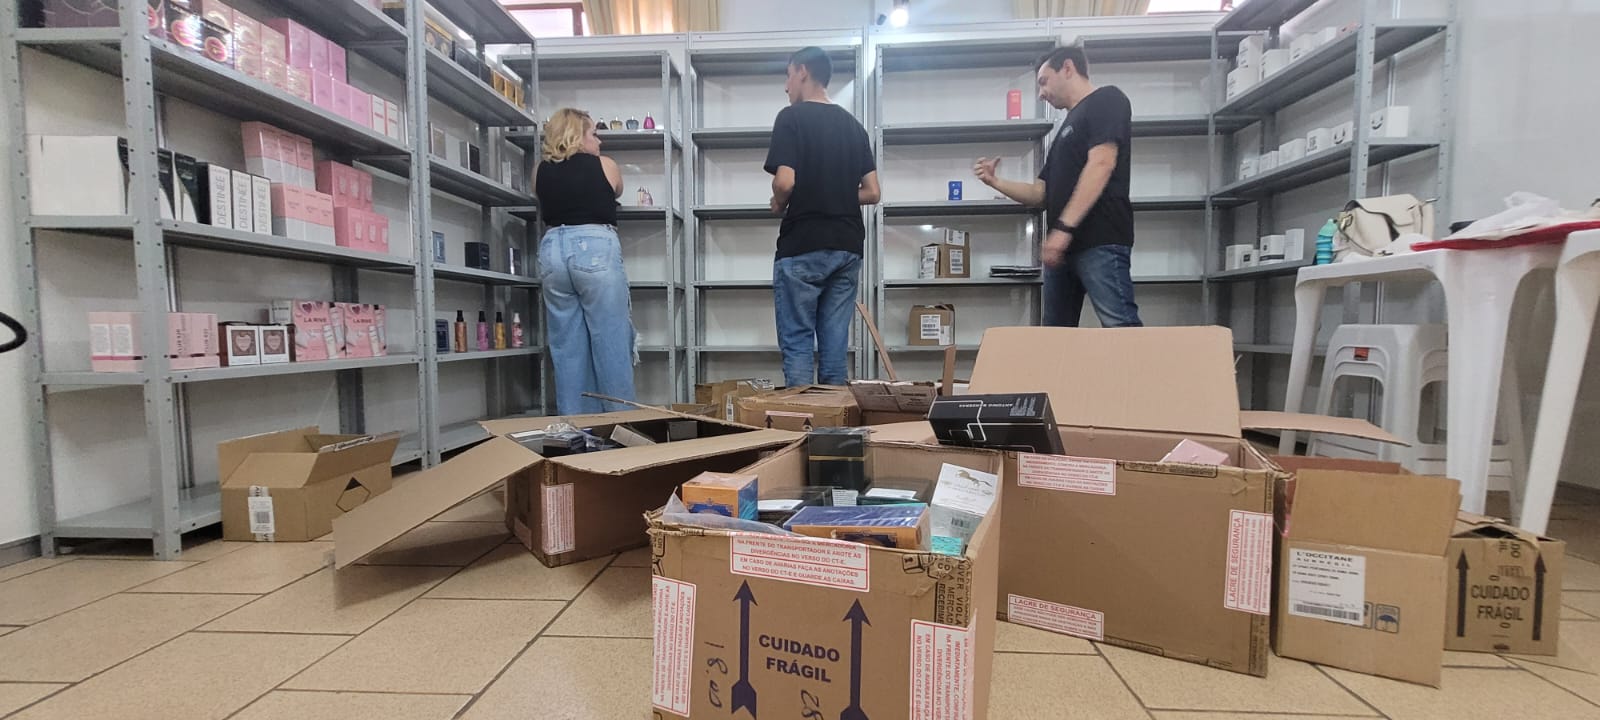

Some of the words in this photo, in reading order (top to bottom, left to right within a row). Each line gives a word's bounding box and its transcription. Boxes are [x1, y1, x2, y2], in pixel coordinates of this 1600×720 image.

[1231, 518, 1242, 565] SEGURANÇA
[1231, 567, 1238, 576] DE
[1470, 584, 1530, 600] CUIDADO
[946, 587, 955, 624] MERCAD
[1014, 598, 1037, 608] LACRE
[1051, 605, 1096, 620] SEGURANÇA
[946, 634, 952, 643] NA
[759, 634, 840, 663] CUIDADO
[766, 656, 831, 683] FRÁGIL
[945, 671, 951, 679] DO
[936, 696, 942, 705] NO
